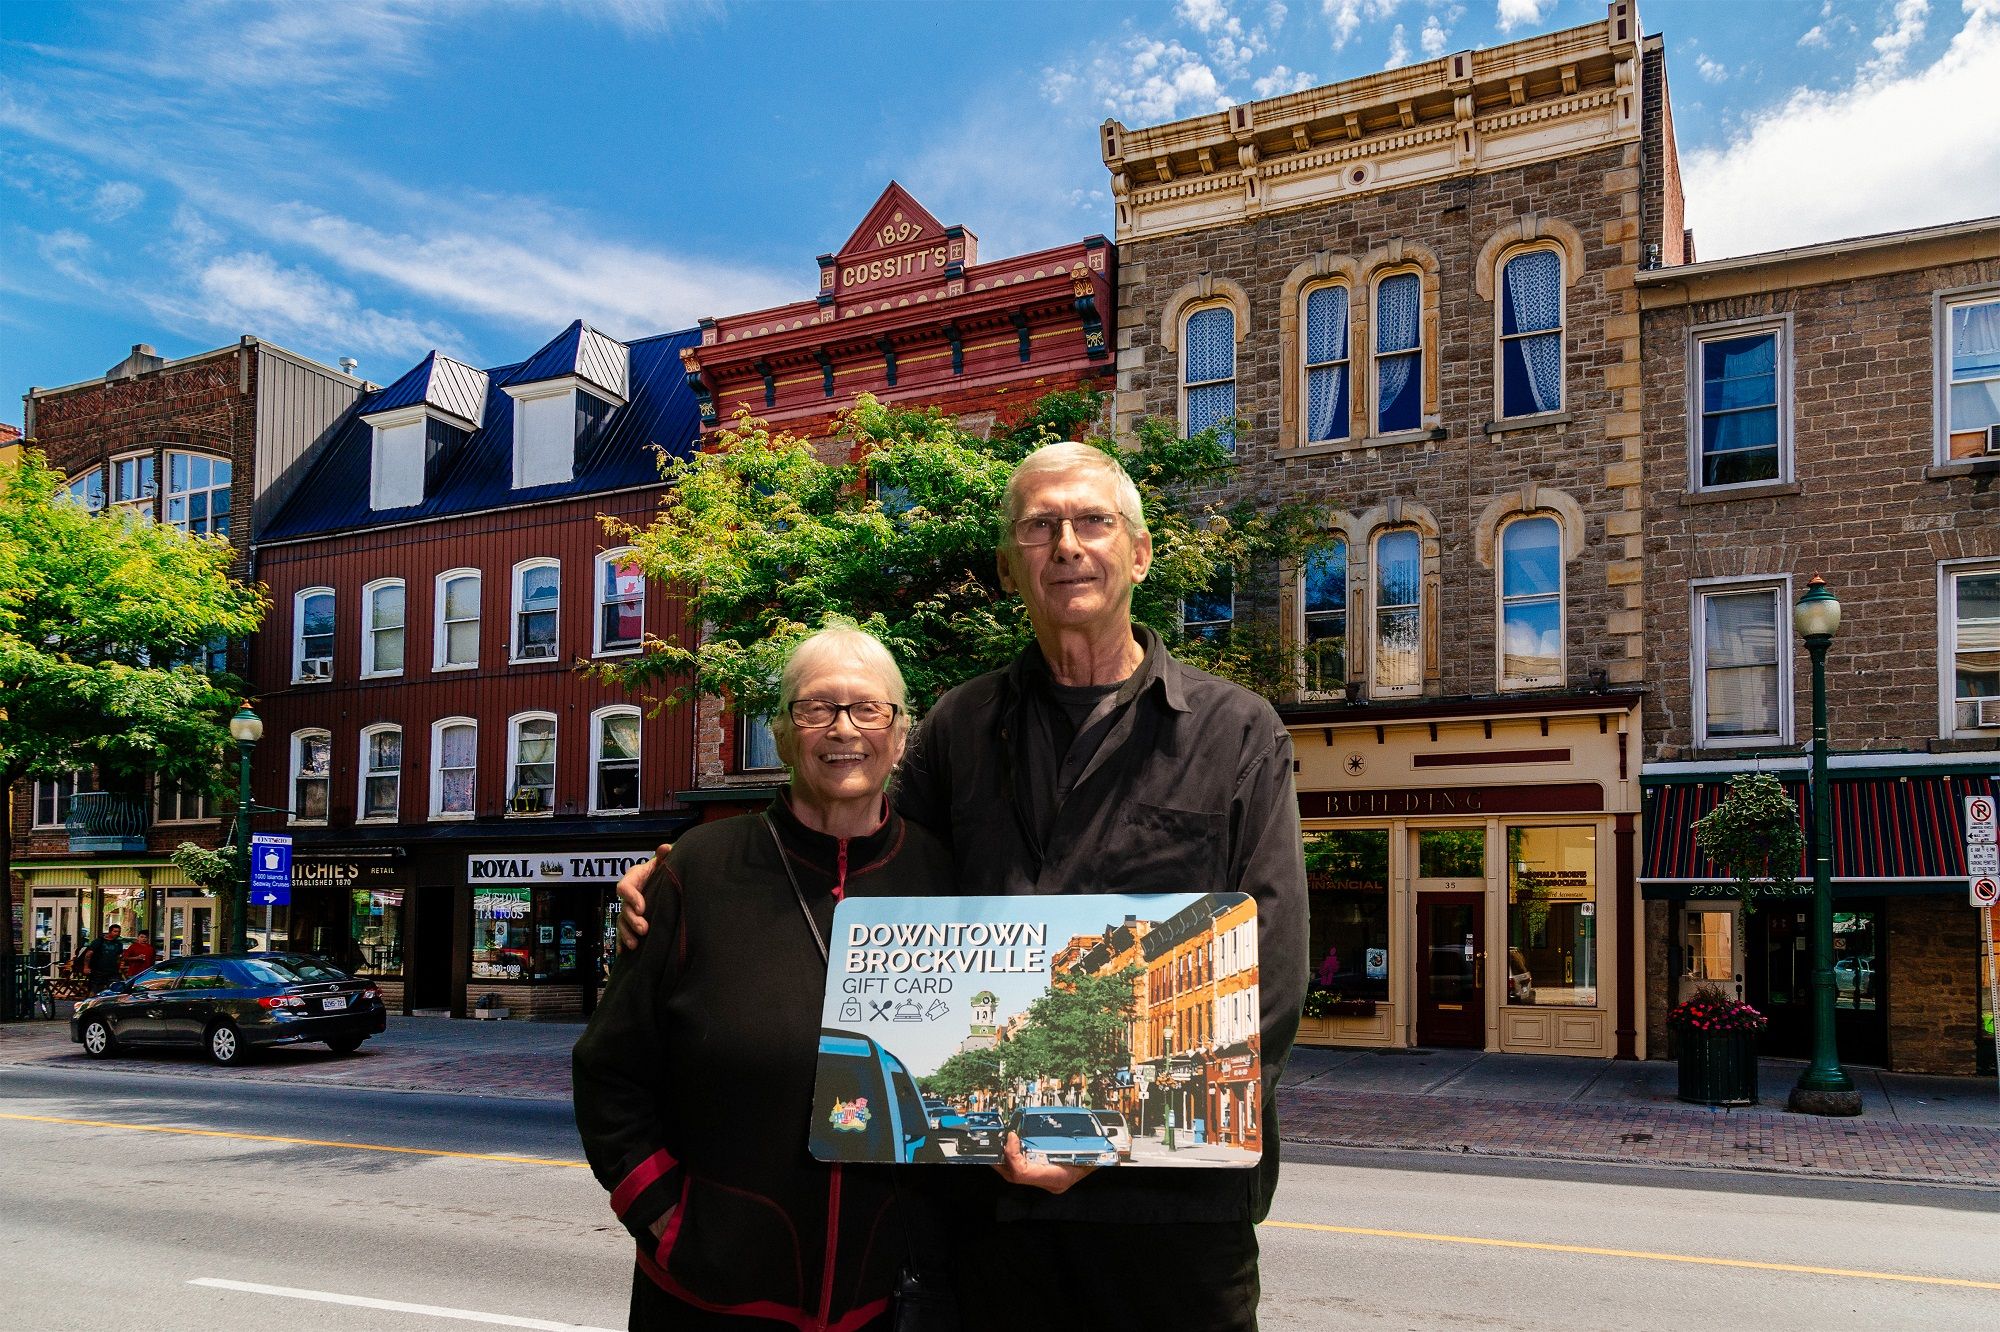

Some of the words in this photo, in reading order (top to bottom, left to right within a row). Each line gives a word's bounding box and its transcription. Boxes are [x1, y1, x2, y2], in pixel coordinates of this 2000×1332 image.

[876, 222, 923, 248] 1897
[842, 247, 947, 287] COSSITT'S
[291, 863, 359, 879] ITCHIE'S
[471, 860, 533, 877] ROYAL
[291, 879, 333, 887] STABLISHED
[848, 922, 1047, 947] DOWNTOWN
[845, 948, 1045, 973] BROCKVILLE
[842, 977, 889, 994] GIFT
[894, 977, 953, 994] CARD
